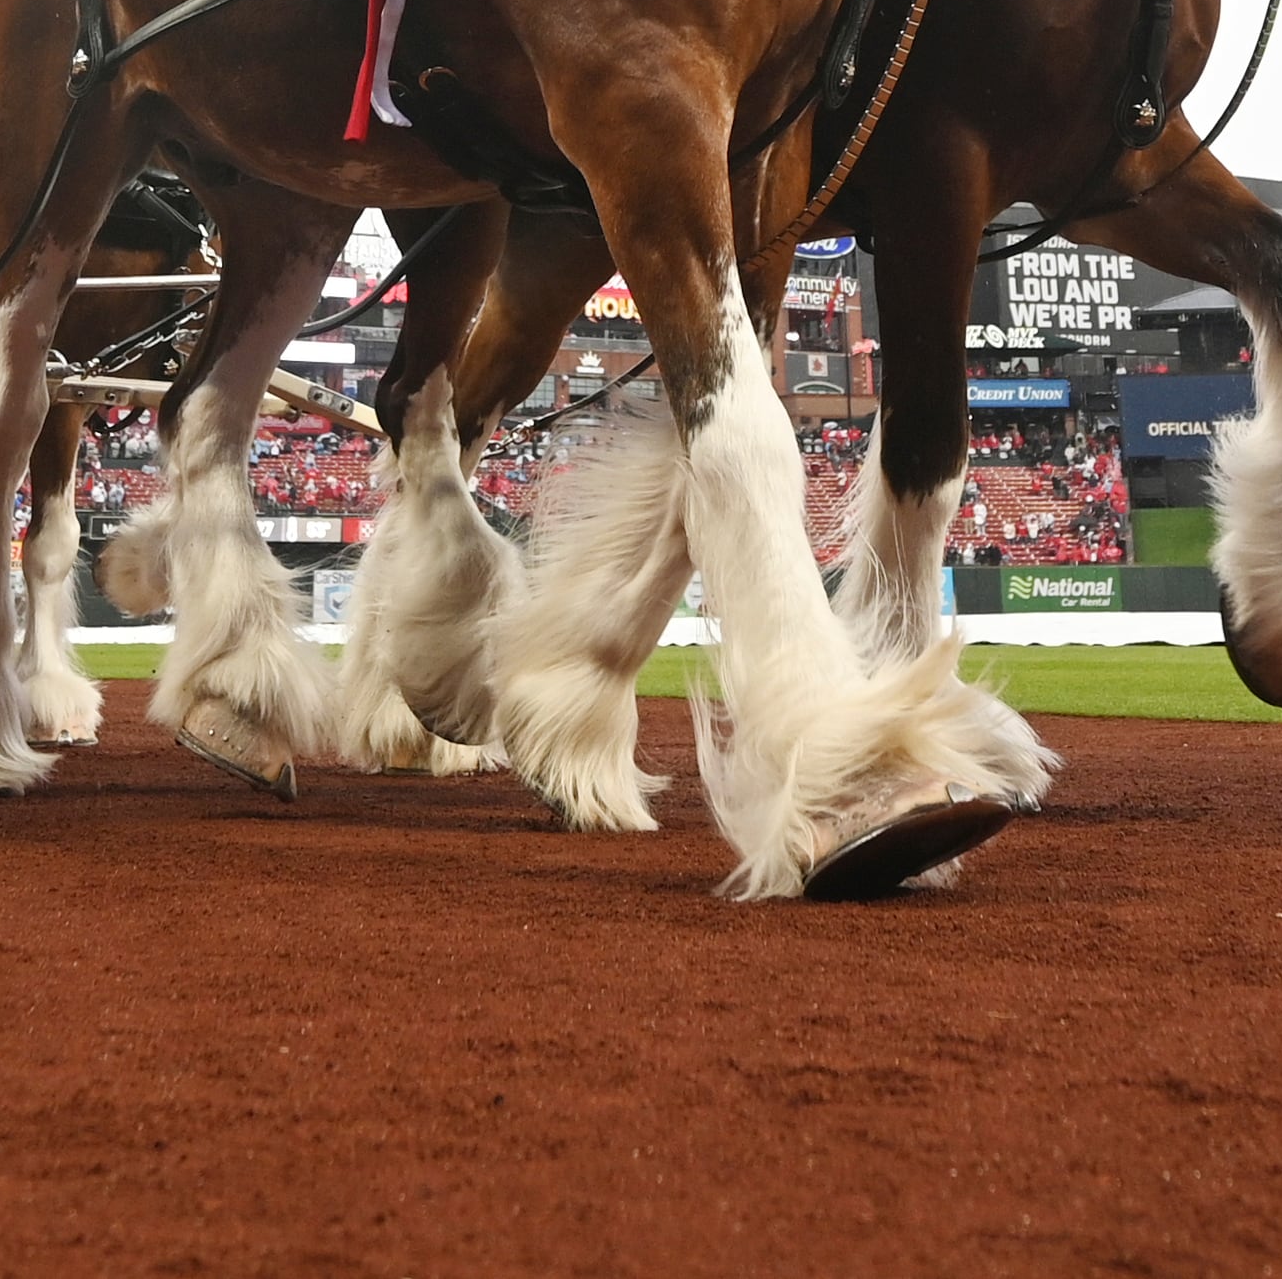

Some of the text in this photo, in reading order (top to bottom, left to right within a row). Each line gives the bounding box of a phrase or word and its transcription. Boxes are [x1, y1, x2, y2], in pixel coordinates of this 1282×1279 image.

[1006, 252, 1136, 279] FROM THE
[1008, 277, 1119, 304] LOU AND
[1009, 302, 1140, 330] WE'RE PR
[1007, 327, 1039, 339] MVP
[1007, 337, 1046, 349] DECK
[966, 385, 1064, 401] CREDIT UNION
[1148, 421, 1212, 437] OFFICIAL
[1032, 577, 1115, 597] National
[1061, 597, 1111, 607] Car Rental
